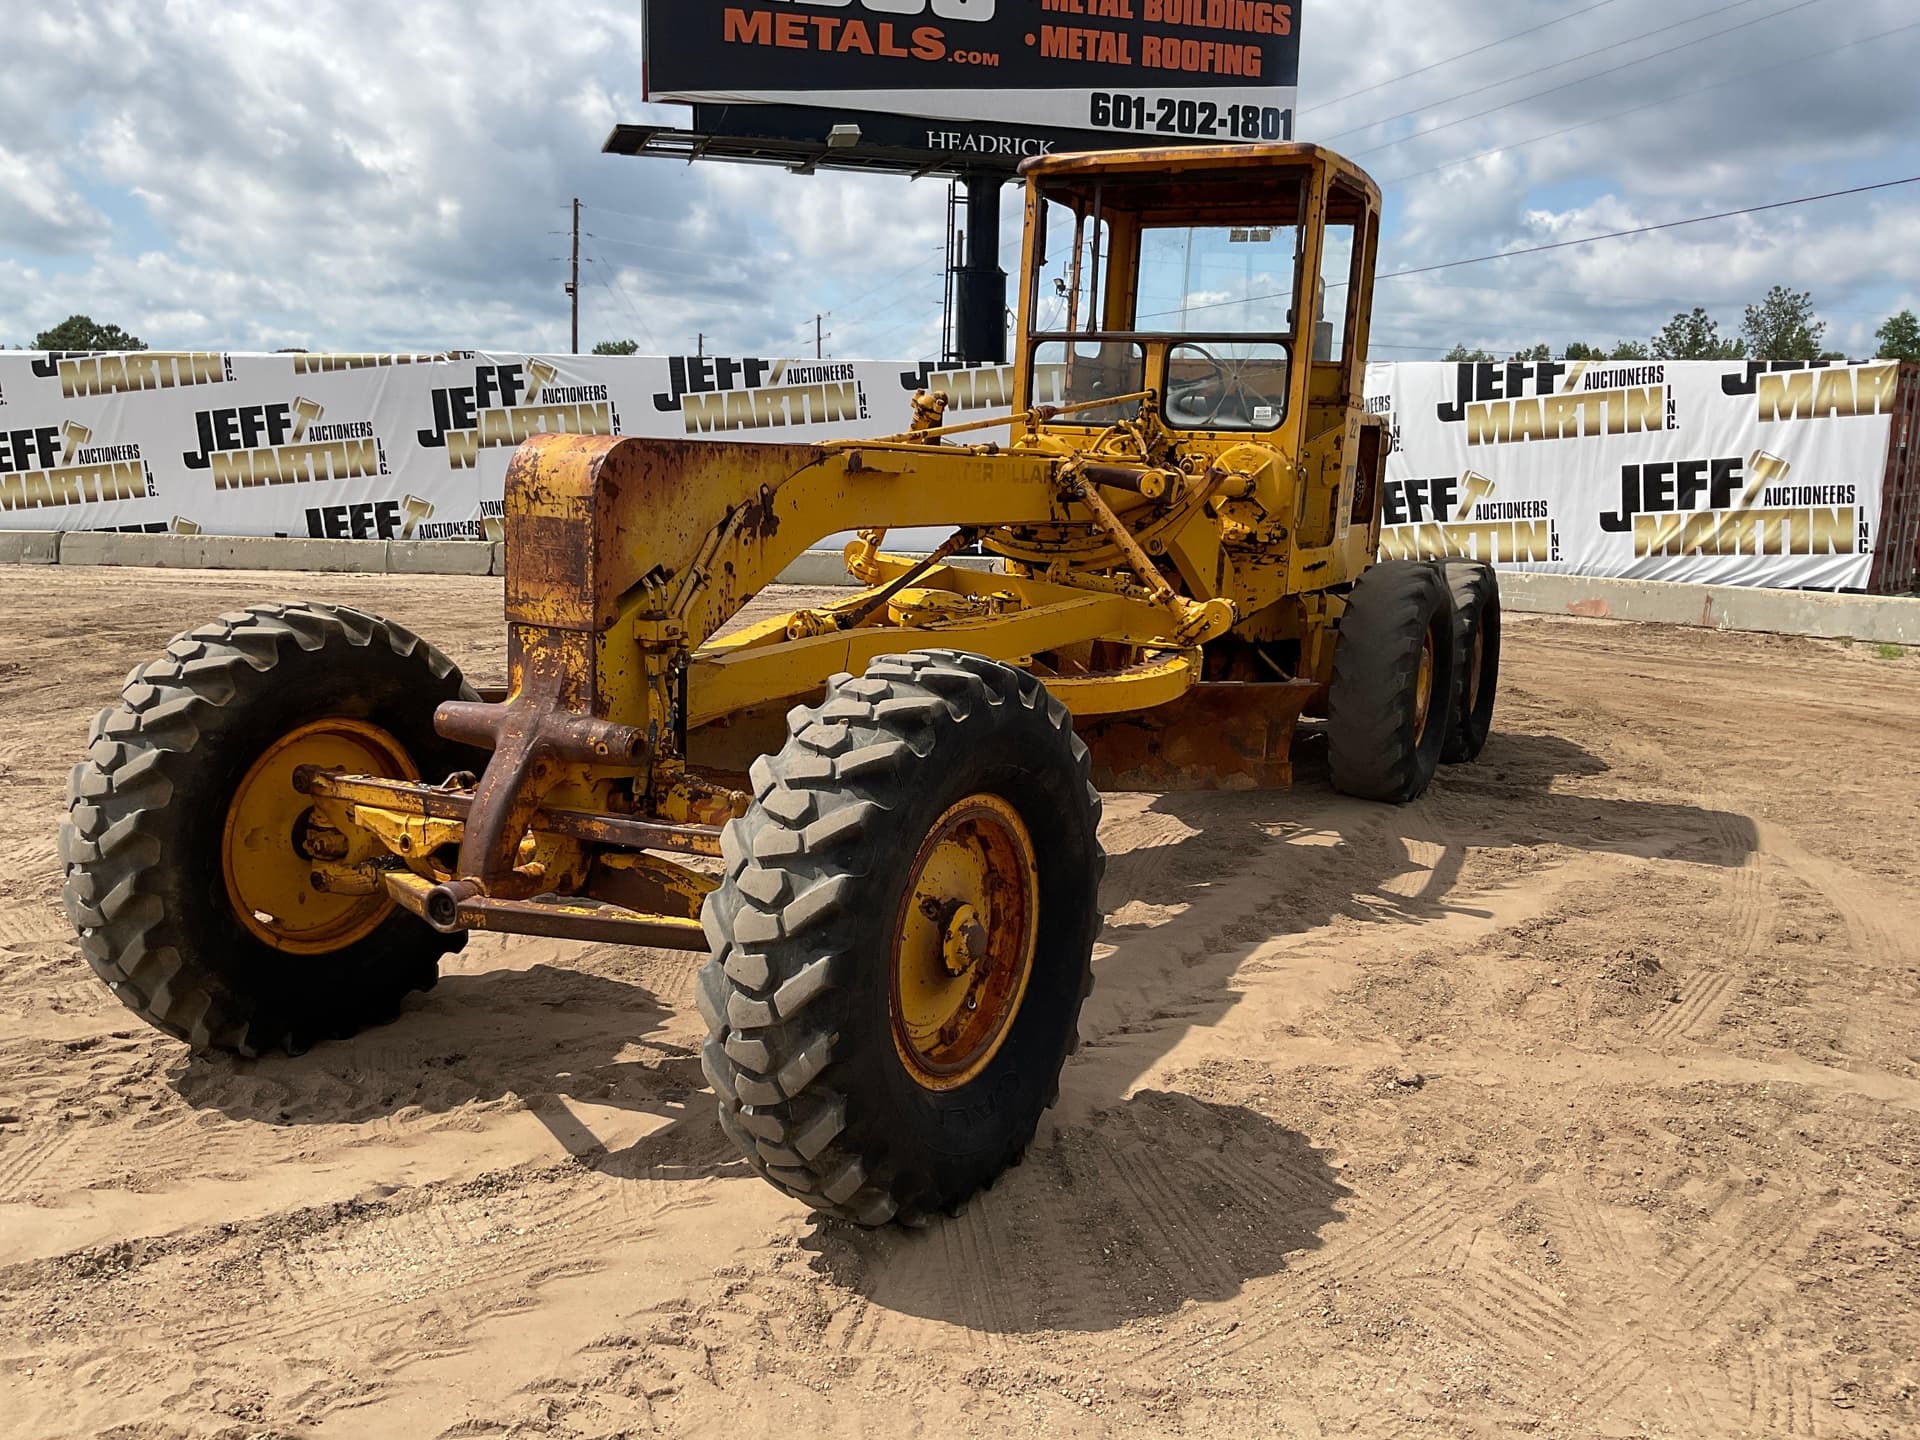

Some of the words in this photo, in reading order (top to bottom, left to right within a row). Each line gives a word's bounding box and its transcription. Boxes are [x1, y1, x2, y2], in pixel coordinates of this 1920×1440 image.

[1143, 0, 1292, 36] BUILDINGS
[1040, 25, 1132, 65] METAL
[1141, 34, 1262, 78] ROOFING
[1090, 91, 1293, 141] 601-202-1801
[926, 130, 1055, 156] HEADRICK
[59, 352, 223, 398] MARTIN
[224, 353, 237, 382] NC.
[653, 356, 769, 411] JEFF
[787, 363, 855, 385] AUCTIONEERS
[1584, 365, 1665, 391] AUCTIONEERS
[417, 364, 524, 448] JEFF
[542, 384, 608, 404] AUCTIONEERS
[682, 381, 857, 434] MARTIN
[857, 380, 871, 420] INC.
[1437, 363, 1565, 422] JEFF
[1666, 384, 1680, 430] INC.
[183, 403, 292, 469] JEFF
[309, 421, 373, 442] AUCTIONEERS
[611, 401, 621, 436] INC
[1466, 386, 1663, 447] MARTIN
[0, 426, 62, 473] FF
[78, 444, 141, 465] AUCTIONEERS
[211, 438, 378, 490] MARTIN
[376, 437, 391, 475] INC.
[0, 461, 146, 512] MARTIN
[144, 459, 159, 497] INC.
[1382, 477, 1458, 525] EFF
[1599, 458, 1743, 532] JEFF
[1764, 484, 1856, 507] AUCTIONEERS
[1475, 500, 1548, 521] AUCTIONEERS
[1634, 506, 1854, 559] MARTIN
[1858, 506, 1873, 554] INC.
[1378, 519, 1548, 564] MARTIN
[1551, 519, 1564, 562] INC.
